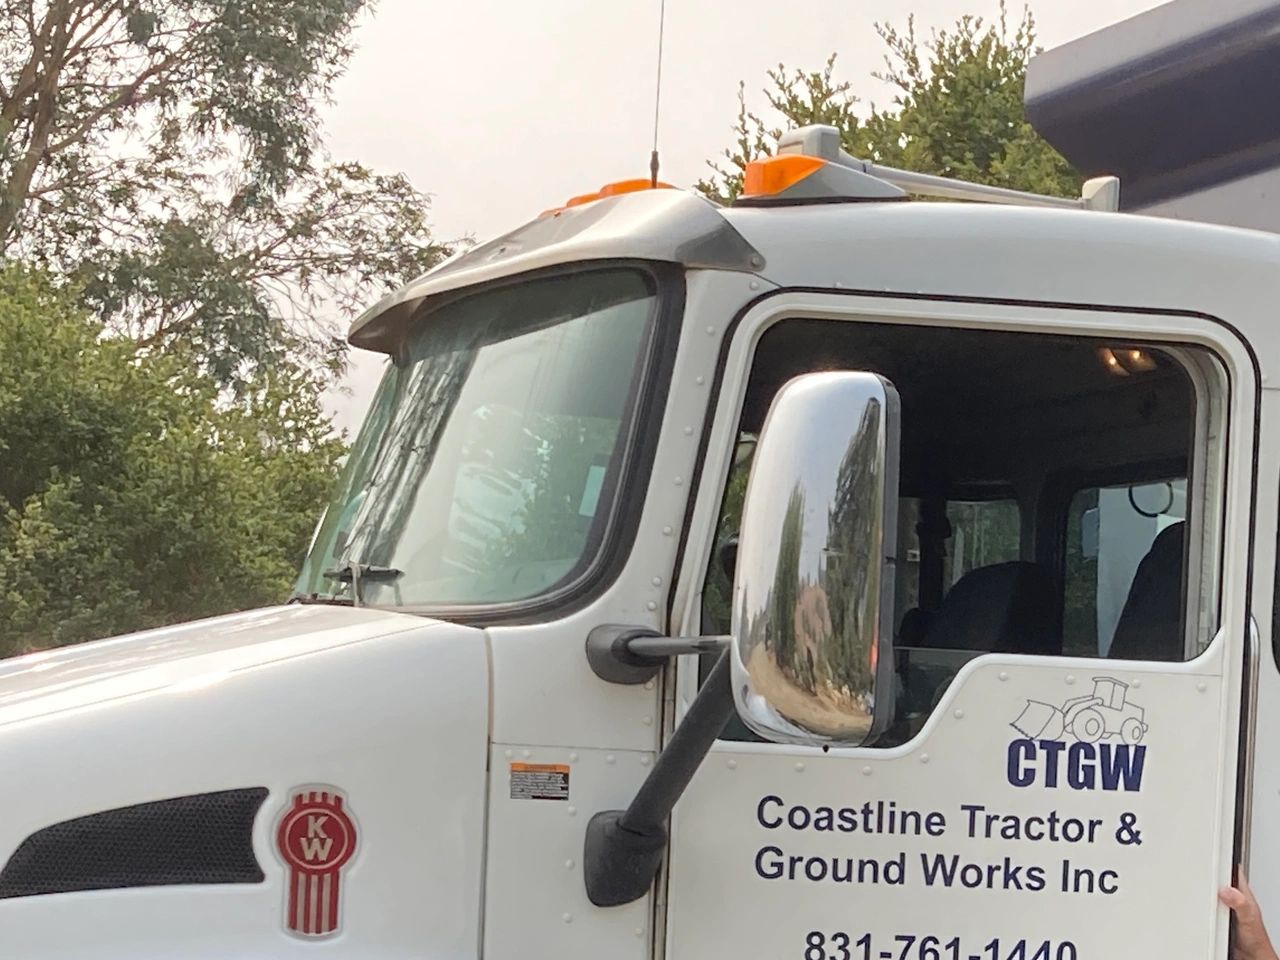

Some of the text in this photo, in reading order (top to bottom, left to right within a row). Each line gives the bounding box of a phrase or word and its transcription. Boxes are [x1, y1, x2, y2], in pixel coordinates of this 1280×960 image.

[1007, 739, 1146, 792] CTGW
[307, 815, 329, 838] K
[757, 795, 1142, 845] Coastline Tractor &
[300, 838, 333, 861] W
[755, 846, 1118, 894] Ground Works Inc
